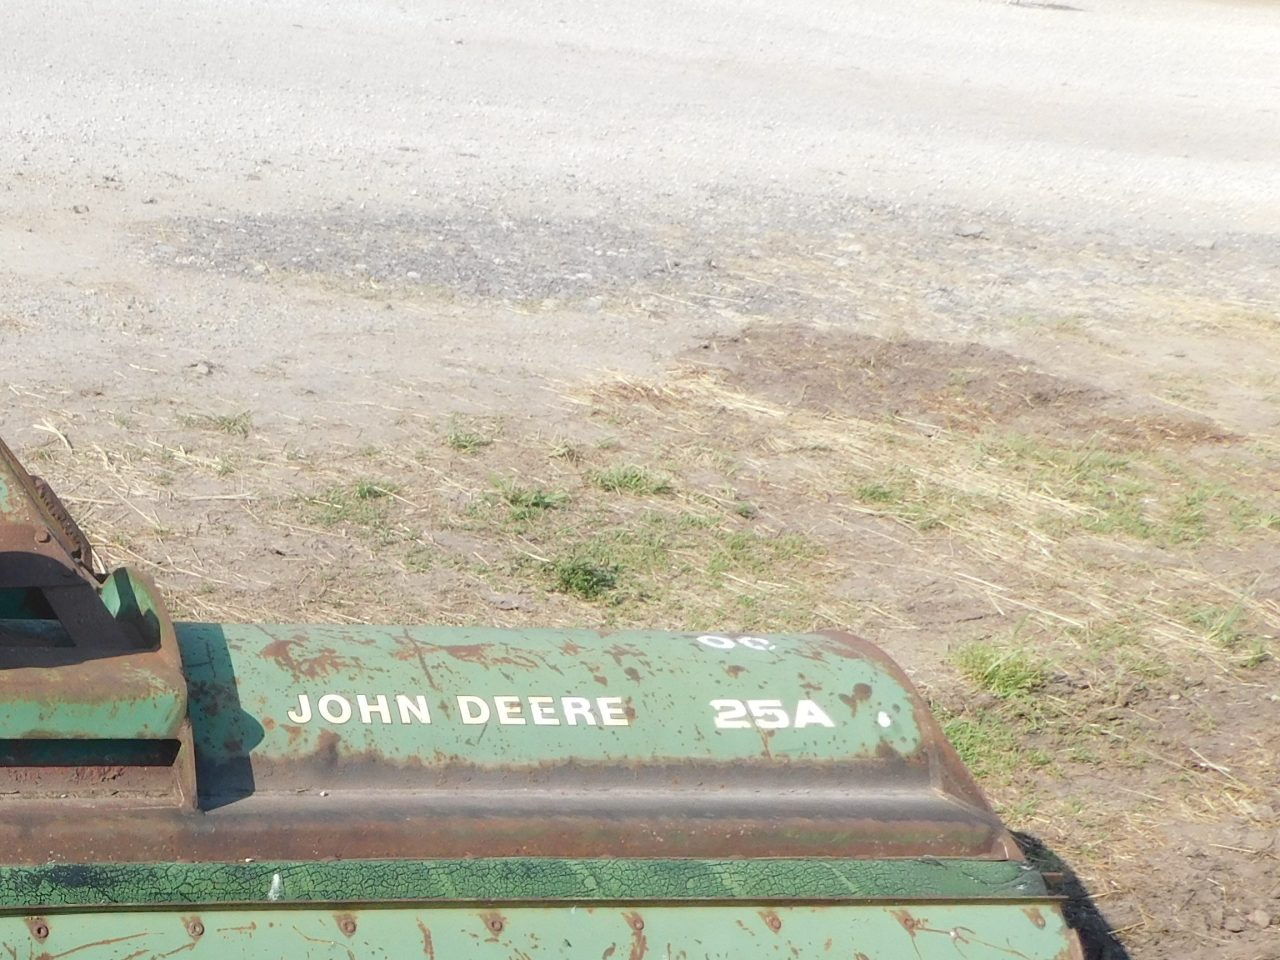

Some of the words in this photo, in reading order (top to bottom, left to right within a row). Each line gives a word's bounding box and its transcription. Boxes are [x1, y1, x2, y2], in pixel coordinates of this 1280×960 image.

[287, 693, 432, 725] JOHN
[456, 695, 630, 727] DEERE
[709, 698, 835, 729] 25A
